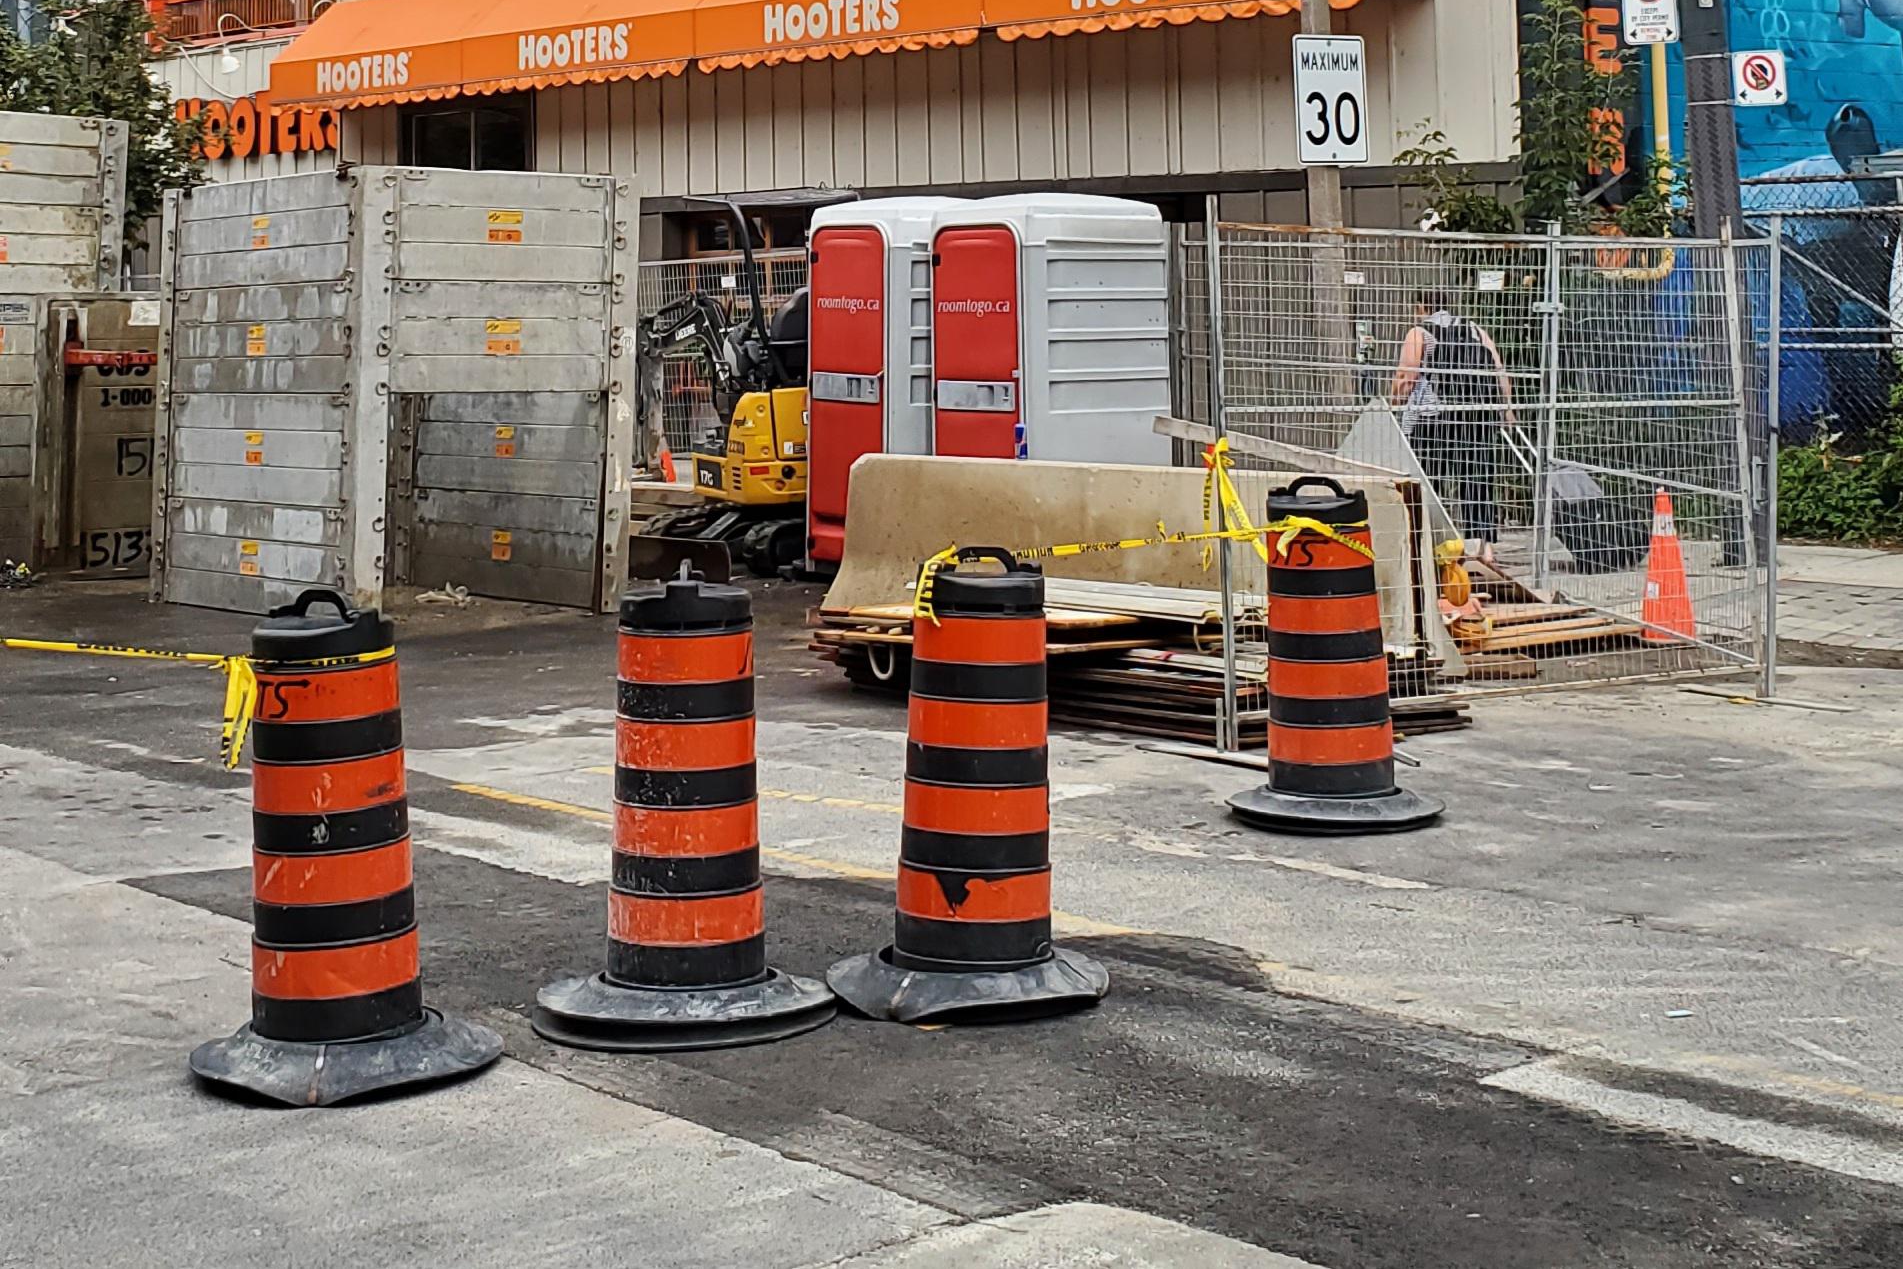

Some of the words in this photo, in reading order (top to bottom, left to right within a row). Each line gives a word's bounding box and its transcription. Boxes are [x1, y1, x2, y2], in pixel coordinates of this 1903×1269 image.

[518, 25, 630, 70] HOOTERS
[1301, 51, 1359, 72] MAXIMUM
[316, 54, 410, 94] HOOTERS
[1305, 91, 1360, 146] 30
[817, 295, 880, 314] roomtogo.ca
[937, 298, 1010, 317] roomtogo.ca
[700, 469, 714, 486] 17G
